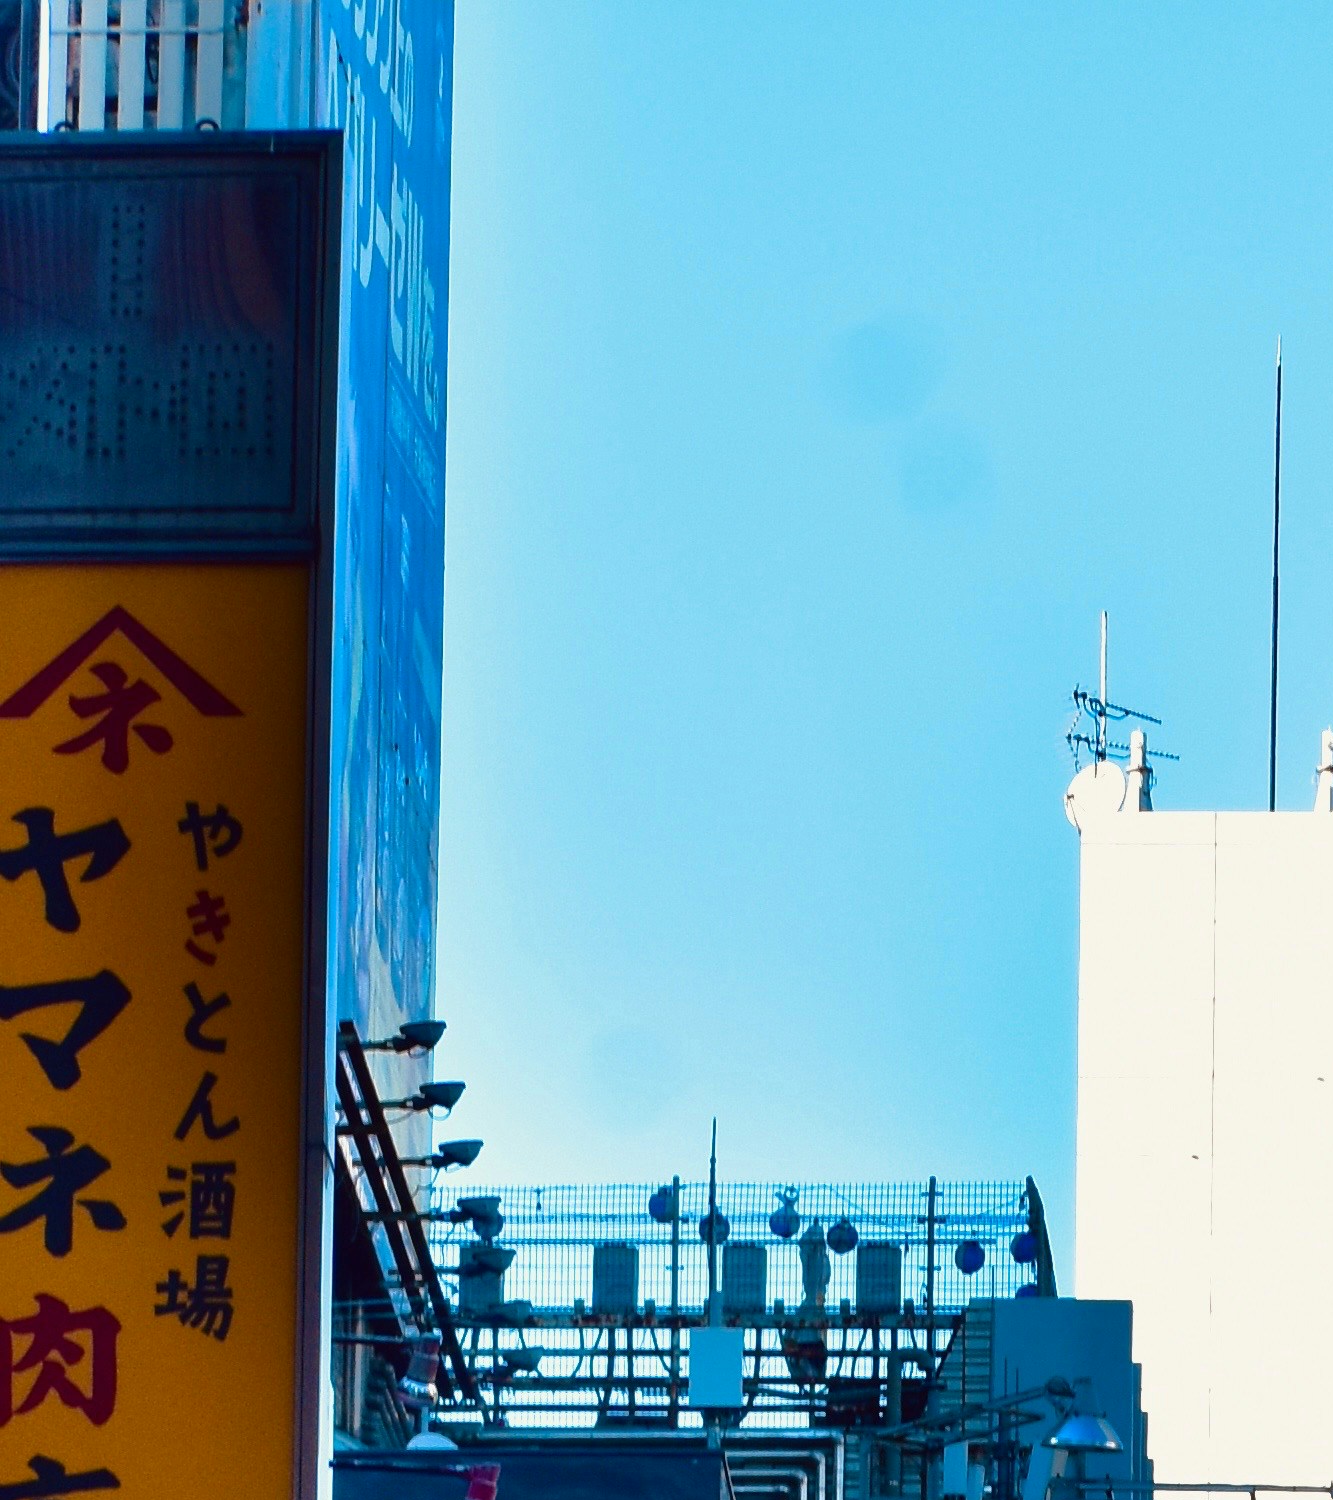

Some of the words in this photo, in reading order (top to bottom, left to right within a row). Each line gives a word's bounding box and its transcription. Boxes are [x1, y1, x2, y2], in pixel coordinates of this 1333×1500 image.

[155, 800, 244, 1342] やきとん酒場
